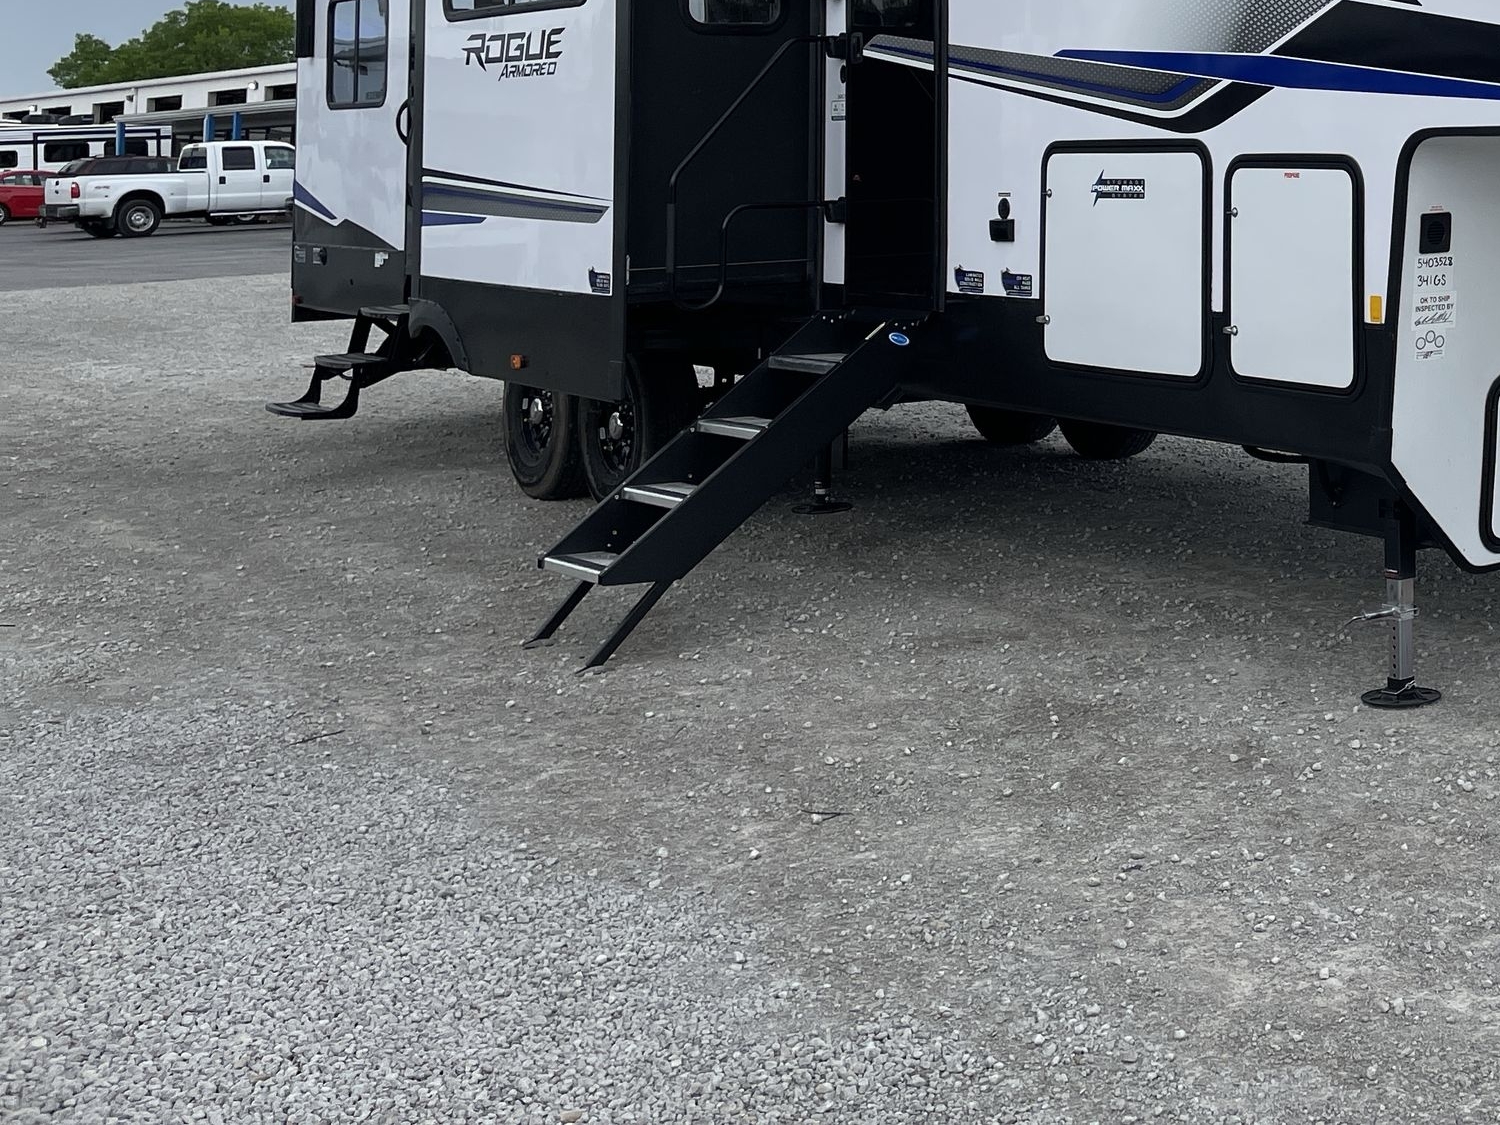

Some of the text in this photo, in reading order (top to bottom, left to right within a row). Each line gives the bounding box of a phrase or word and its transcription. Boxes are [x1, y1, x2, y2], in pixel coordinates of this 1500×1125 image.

[461, 27, 566, 72] ROGUE
[498, 61, 557, 81] ARMORED
[1417, 256, 1453, 269] 5403528
[1438, 295, 1450, 303] SHIP
[1415, 304, 1445, 312] INSPECTED
